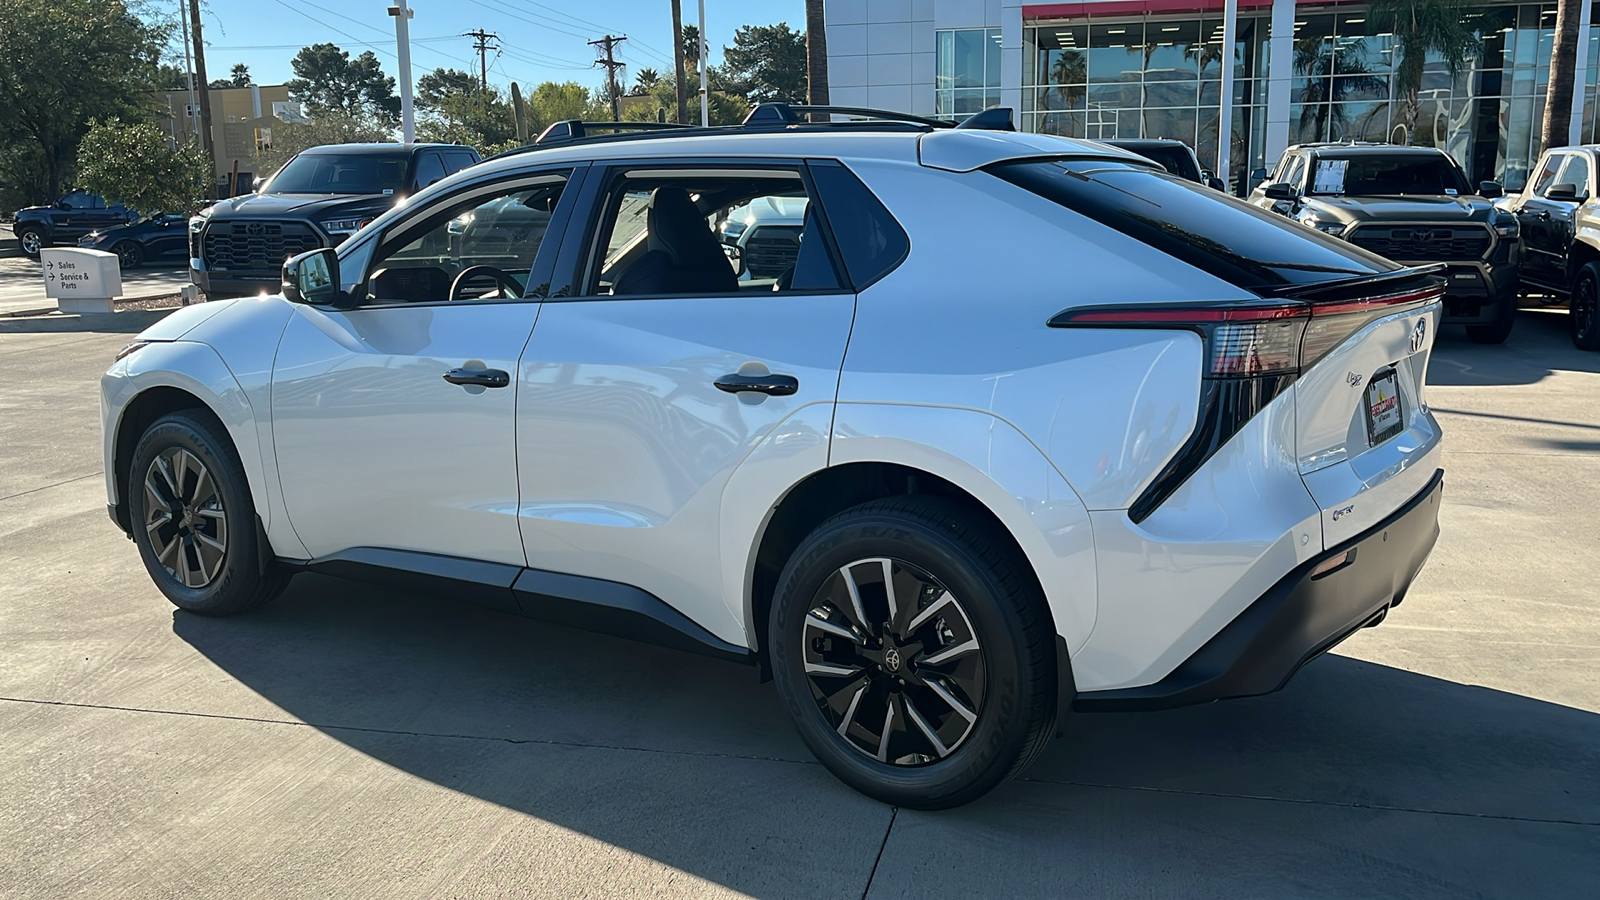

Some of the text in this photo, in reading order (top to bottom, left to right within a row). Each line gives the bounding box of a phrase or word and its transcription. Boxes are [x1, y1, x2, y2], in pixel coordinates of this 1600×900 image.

[58, 261, 75, 269] Sales
[60, 272, 89, 280] Service &
[61, 281, 77, 289] Parts
